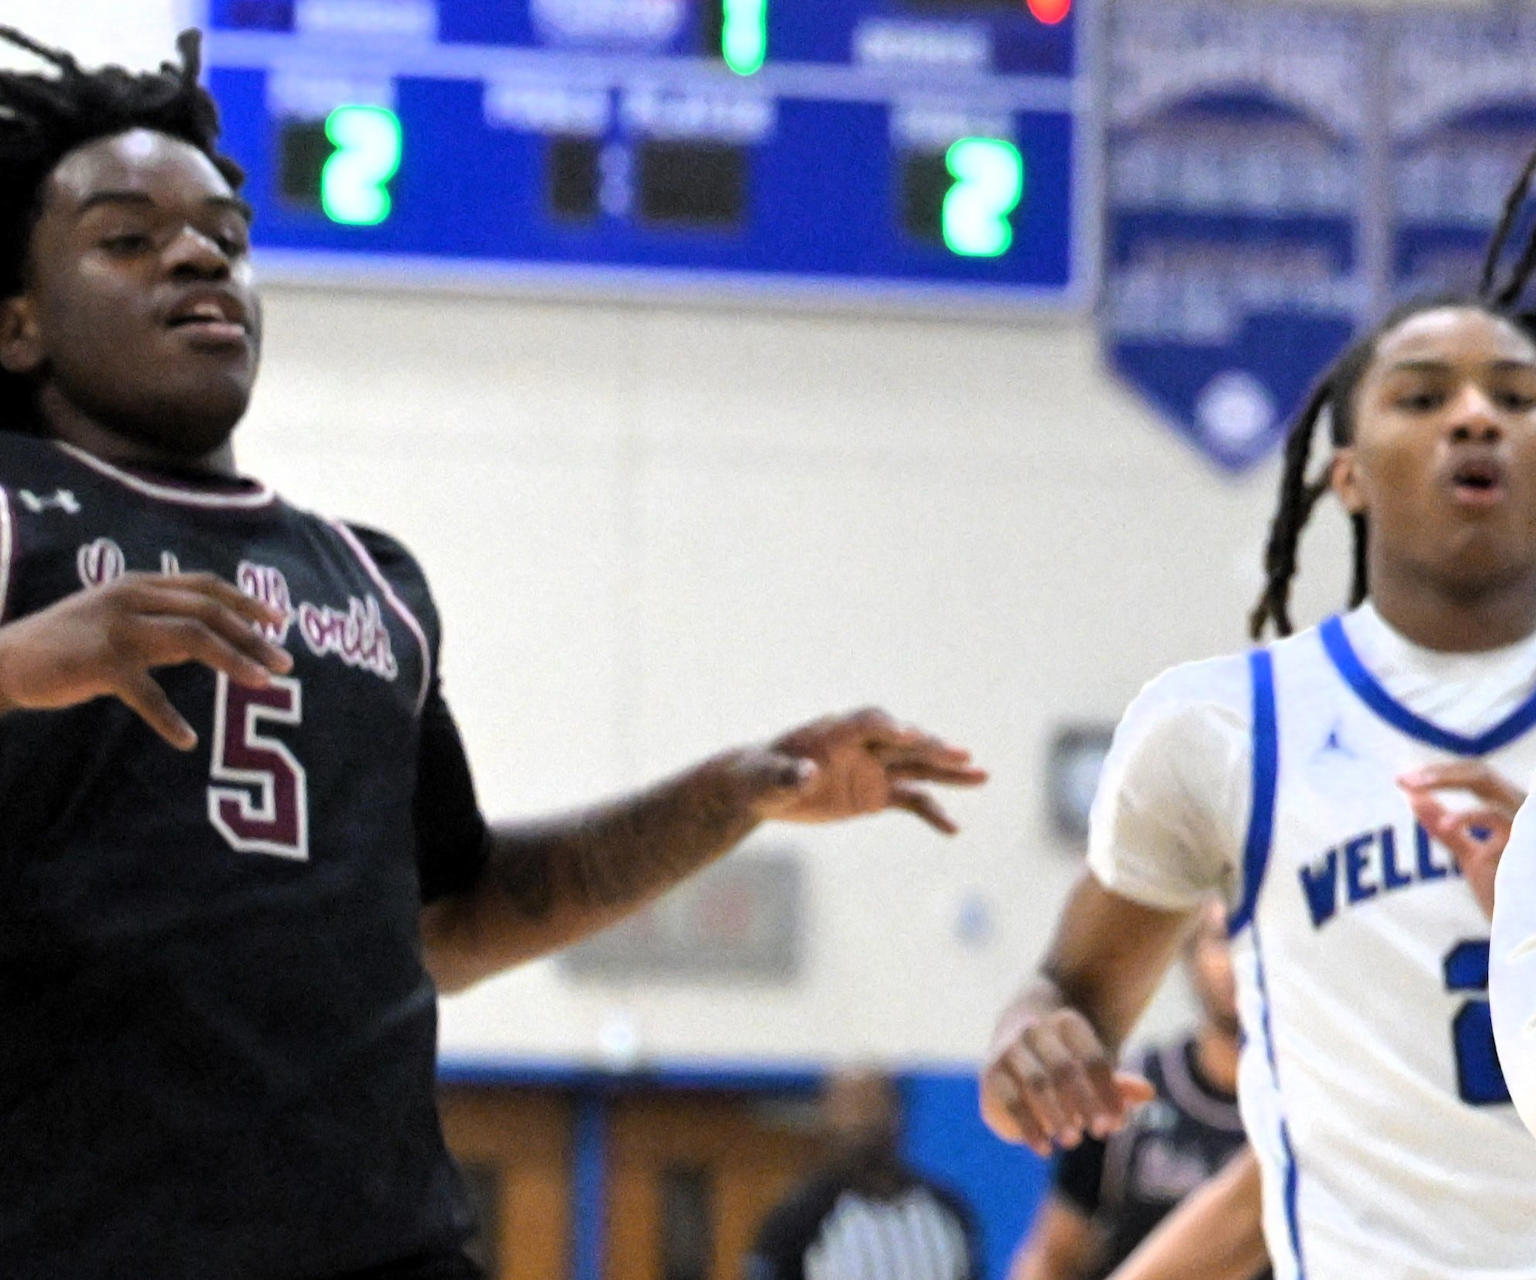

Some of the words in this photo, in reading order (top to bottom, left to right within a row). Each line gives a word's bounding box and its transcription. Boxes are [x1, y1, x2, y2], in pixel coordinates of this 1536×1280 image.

[321, 102, 403, 226] 2
[941, 135, 1024, 258] 2
[207, 671, 309, 861] 5
